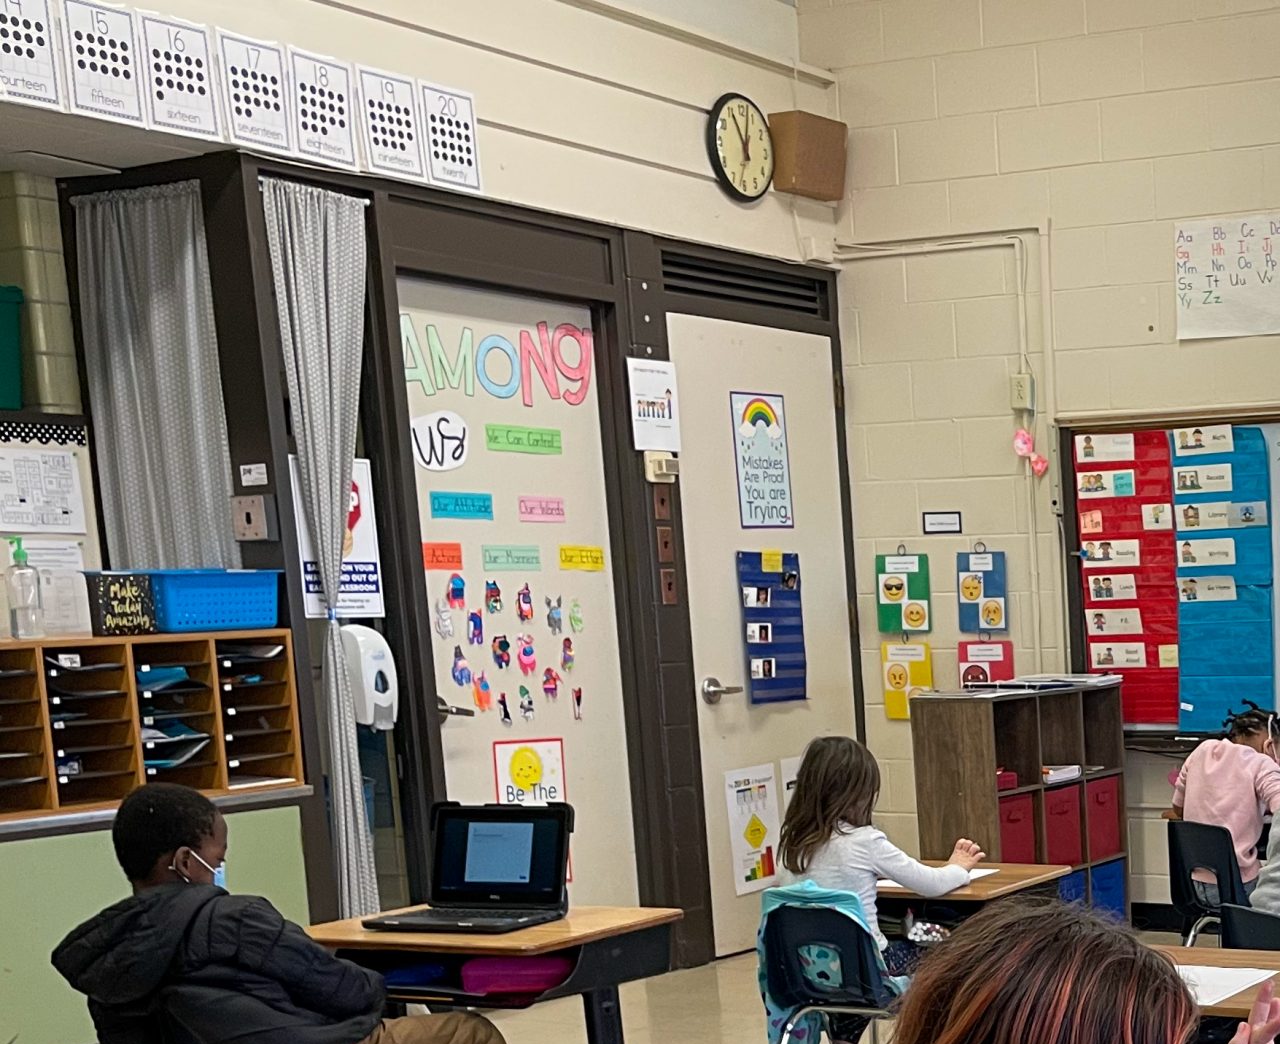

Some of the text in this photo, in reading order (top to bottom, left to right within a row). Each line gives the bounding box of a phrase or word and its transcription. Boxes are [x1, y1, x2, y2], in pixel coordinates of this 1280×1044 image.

[91, 10, 108, 35] 15
[168, 28, 185, 52] 16
[247, 47, 260, 69] 17
[314, 64, 329, 87] 18
[381, 80, 396, 102] 19
[438, 96, 457, 117] 20
[1177, 230, 1192, 242] Aa
[1213, 227, 1226, 240] Bb
[1241, 223, 1255, 237] Cc
[1177, 246, 1190, 262] Gg
[1212, 243, 1225, 256] Hh
[1238, 240, 1249, 254] Ii
[1262, 238, 1272, 254] Jj
[1177, 262, 1197, 274] Mm
[1212, 259, 1225, 272] Nn
[1238, 256, 1252, 269] Oo
[1266, 254, 1277, 271] Pp
[1178, 277, 1192, 291] Ss
[1205, 275, 1220, 288] Tt
[1230, 273, 1246, 287] Uu
[1257, 270, 1273, 284] Vv
[1178, 291, 1223, 309] Yy Zz
[487, 429, 499, 443] We
[506, 430, 522, 444] Can
[742, 456, 783, 469] Mistakes
[744, 471, 759, 483] Are
[745, 485, 785, 500] You are
[111, 580, 140, 601] Make
[106, 614, 149, 629] Amazing
[111, 598, 142, 625] Today
[506, 783, 557, 803] Be The
